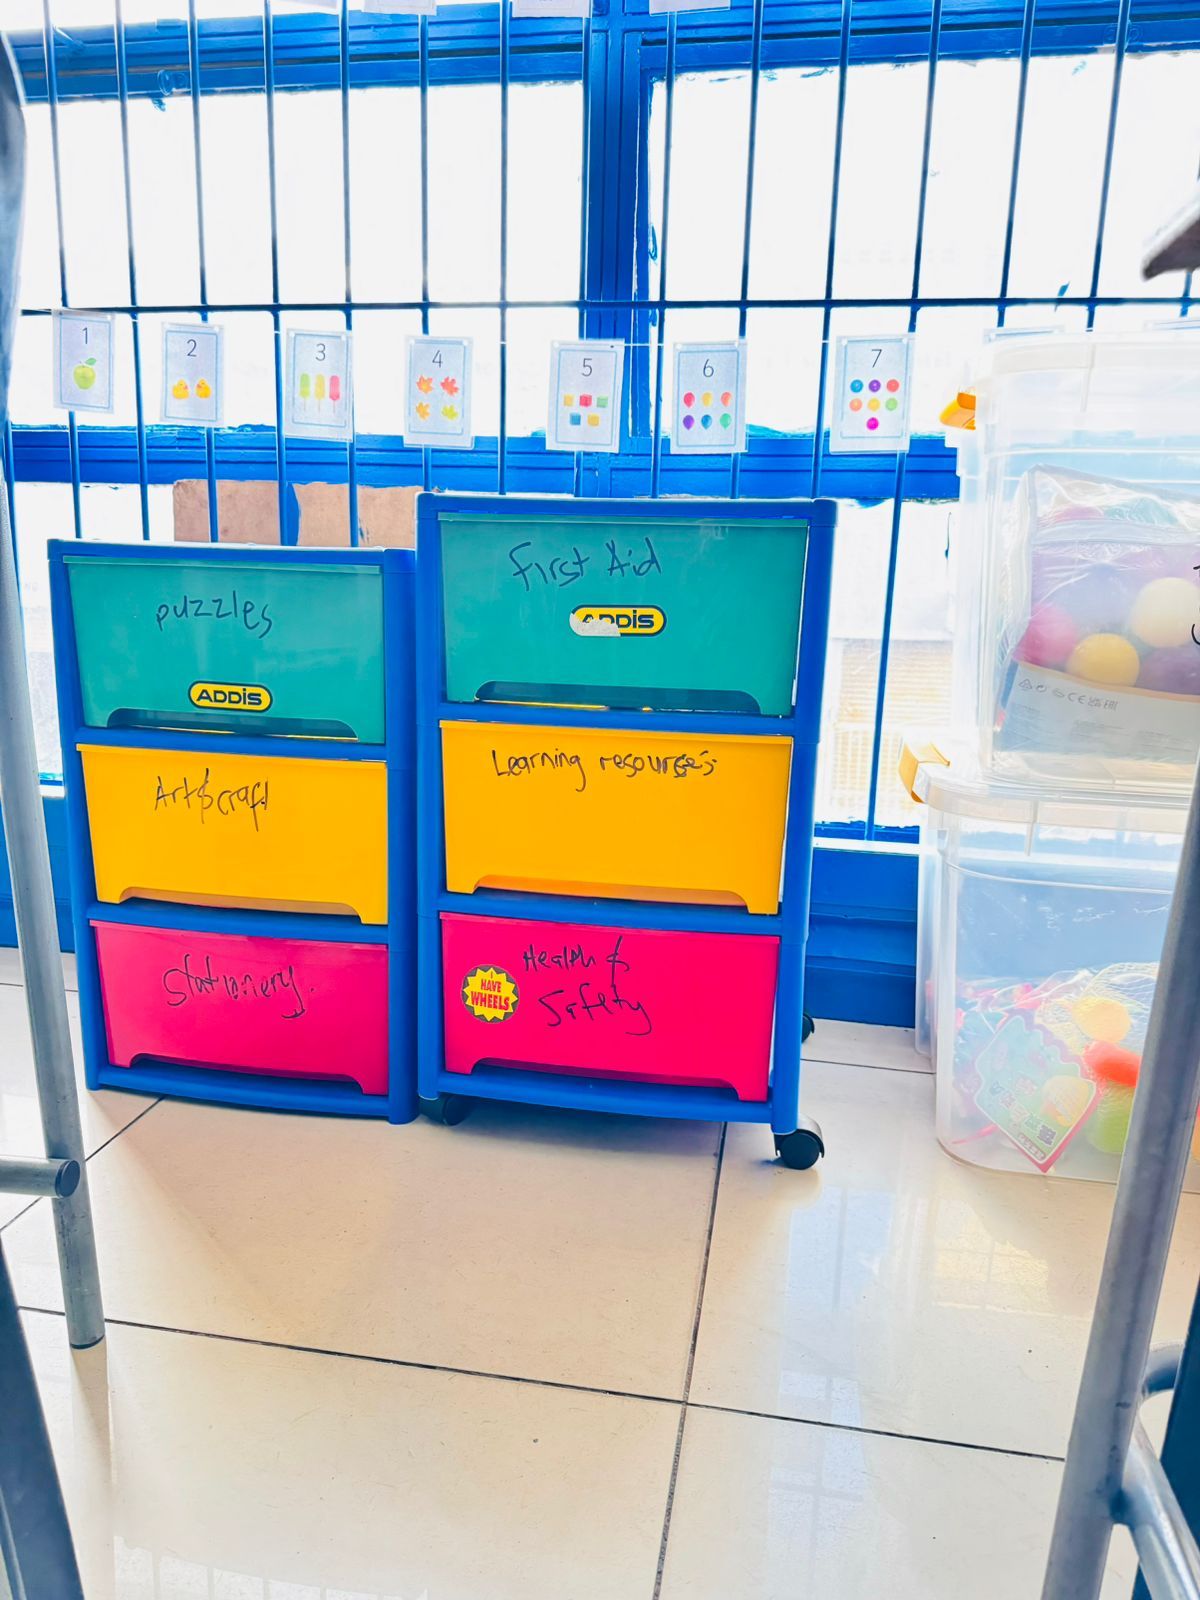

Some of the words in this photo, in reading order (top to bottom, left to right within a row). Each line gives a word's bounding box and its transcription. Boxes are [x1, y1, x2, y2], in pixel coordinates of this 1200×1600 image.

[81, 327, 90, 345] 1
[186, 339, 198, 357] 2
[315, 343, 327, 361] 3
[432, 350, 444, 368] 4
[580, 358, 594, 377] 5
[702, 358, 715, 378] 6
[870, 348, 883, 369] 7
[605, 537, 662, 577] Aid
[156, 590, 273, 640] puzzles
[491, 749, 587, 793] Learning
[481, 979, 502, 993] HAVE
[470, 991, 510, 1011] WHEELS
